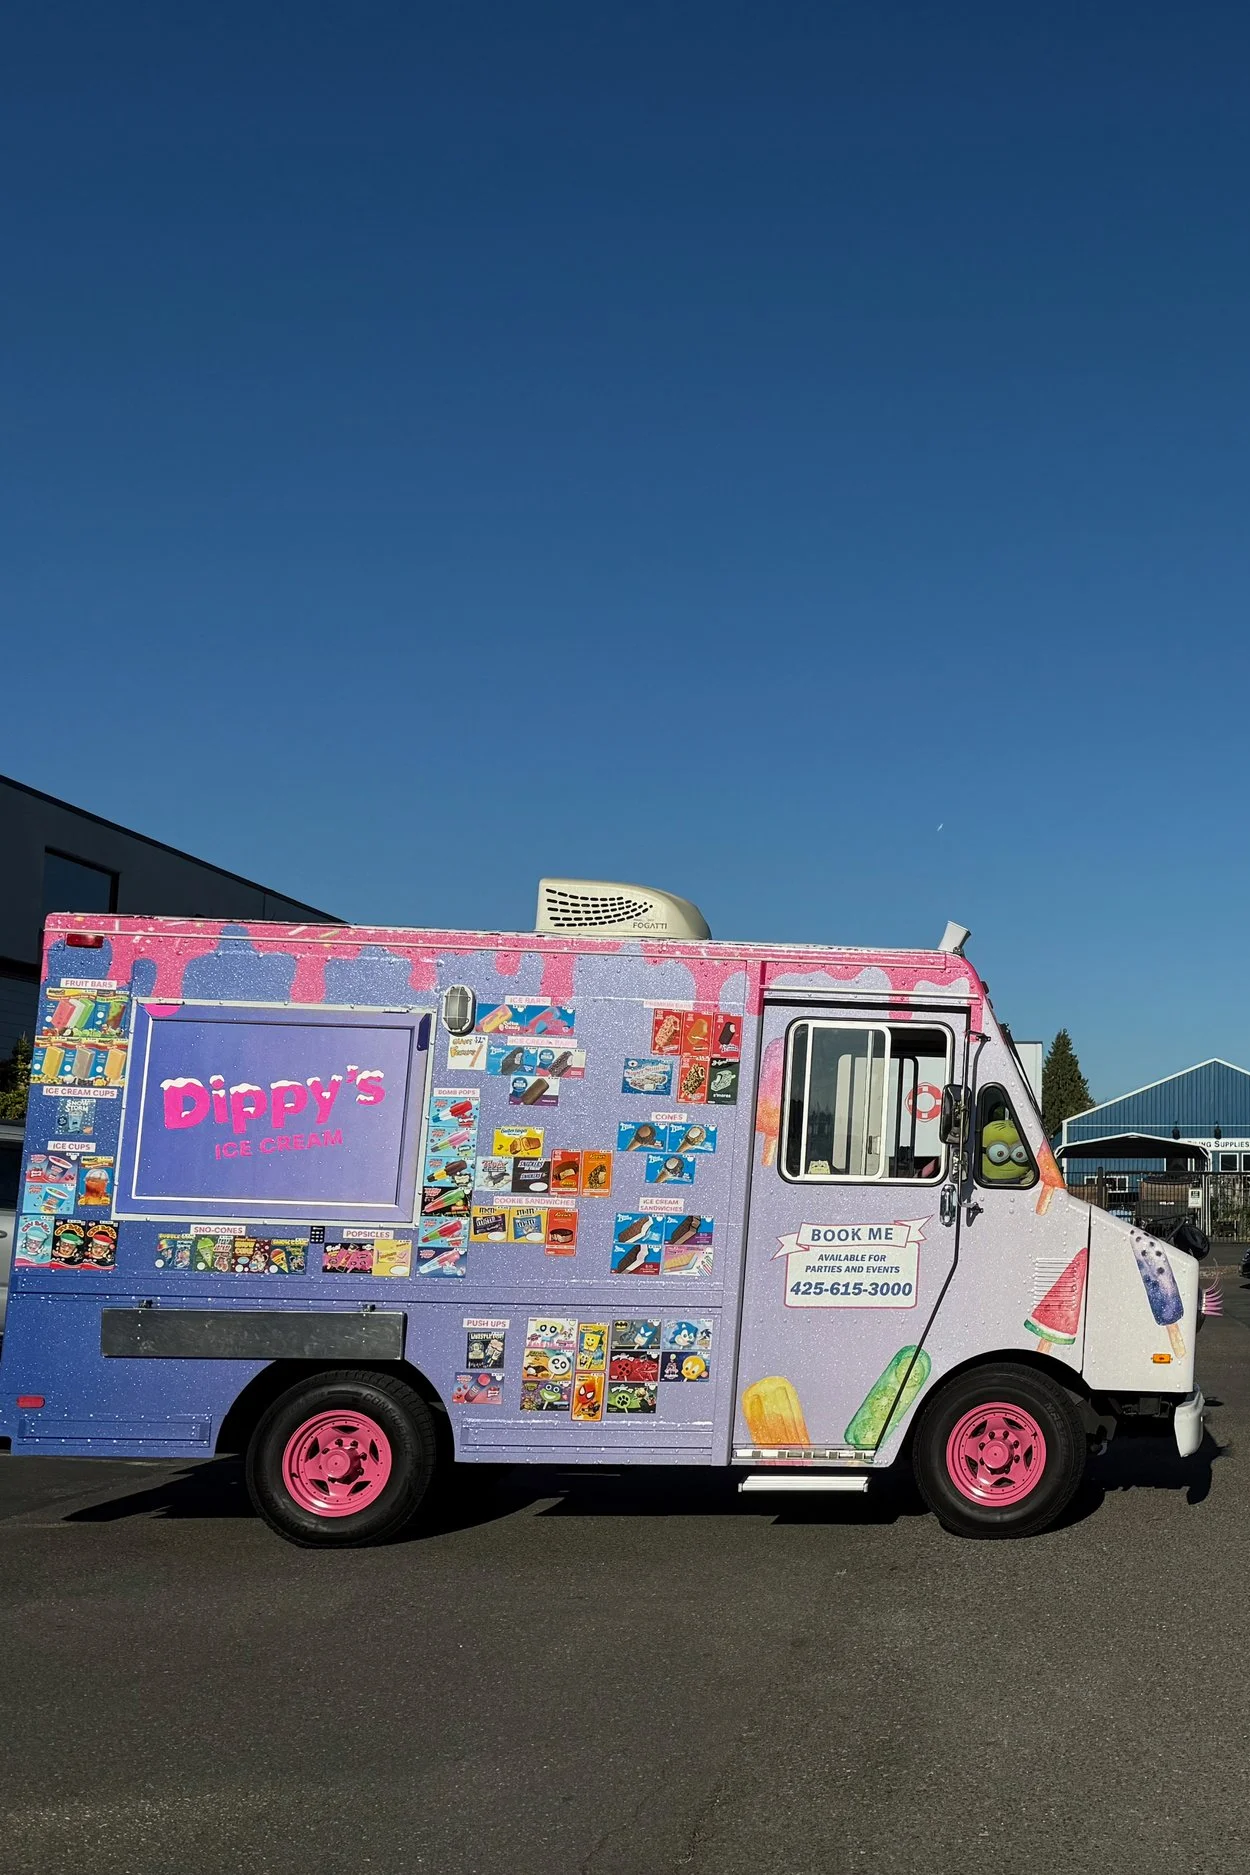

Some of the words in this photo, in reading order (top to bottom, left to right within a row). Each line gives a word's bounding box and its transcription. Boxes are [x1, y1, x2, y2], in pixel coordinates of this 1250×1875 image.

[632, 921, 668, 930] FOGATTI
[64, 979, 88, 987] FRUIT
[90, 980, 113, 988] BARS
[46, 1087, 59, 1095] ICE
[61, 1088, 91, 1096] CREAM
[93, 1089, 115, 1097] CUPS
[160, 1064, 386, 1135] Dippy's
[53, 1142, 67, 1150] ICE
[68, 1143, 91, 1151] CUPS
[215, 1140, 253, 1160] ICE
[260, 1129, 344, 1154] CREAM
[525, 1198, 575, 1206] SANDWICHES
[194, 1226, 243, 1234] SNO-CONES
[346, 1230, 390, 1238] POPSICLES
[811, 1228, 862, 1242] BOOK
[868, 1227, 894, 1241] ME
[817, 1254, 866, 1262] AVAILABLE
[868, 1254, 886, 1262] FOR
[805, 1265, 842, 1273] PARTIES
[844, 1265, 864, 1273] AND
[790, 1281, 913, 1296] 425-615-3000
[467, 1319, 488, 1327] PUSH
